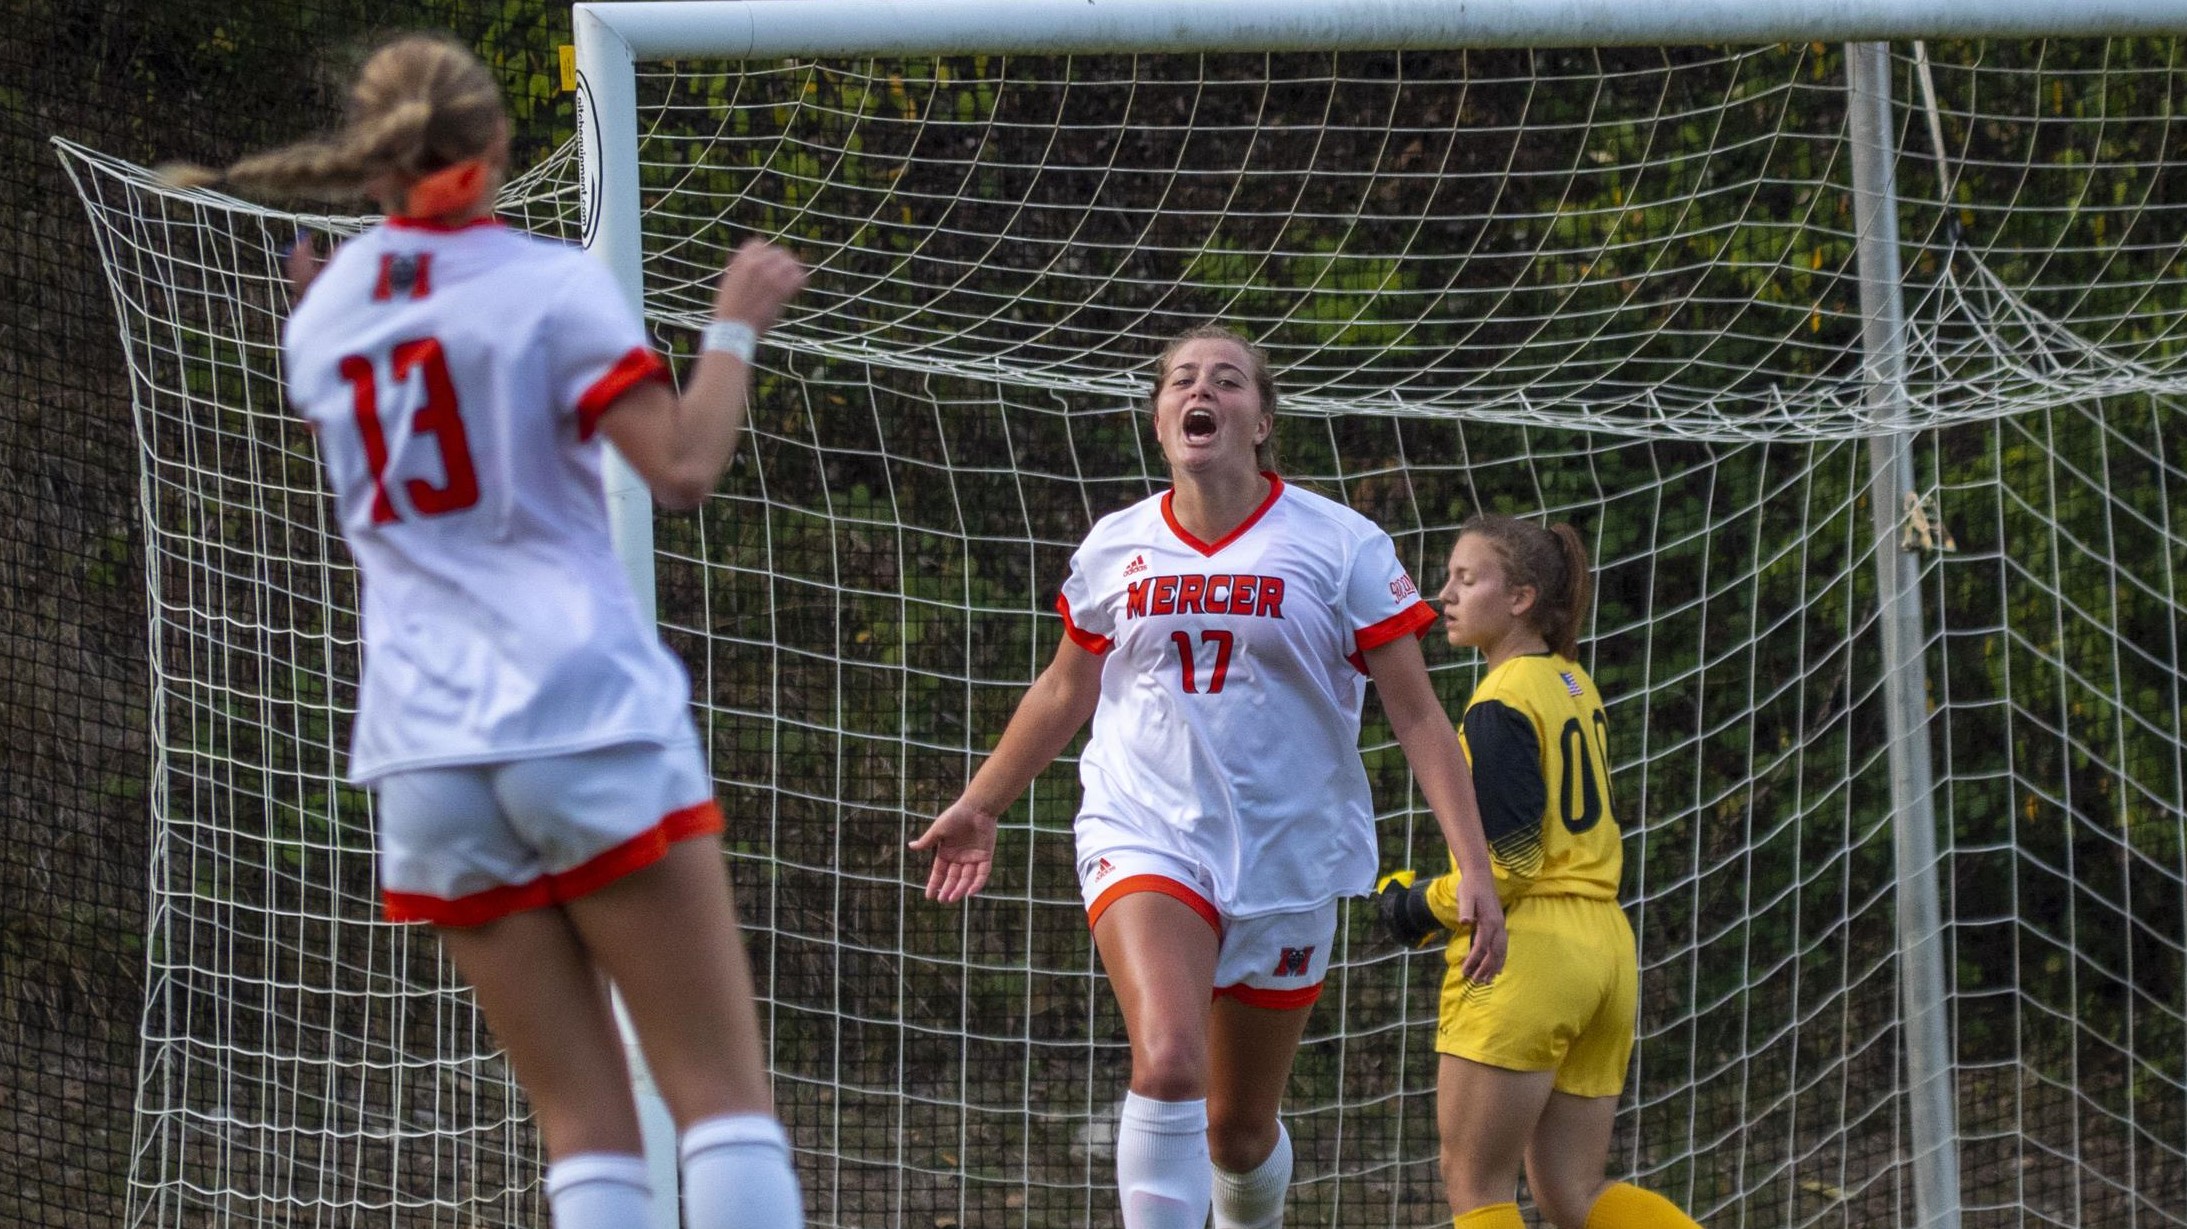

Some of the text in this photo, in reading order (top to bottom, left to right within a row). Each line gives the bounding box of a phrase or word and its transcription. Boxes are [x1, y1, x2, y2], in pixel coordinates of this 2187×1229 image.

[338, 336, 479, 524] 13
[1123, 564, 1148, 577] adidas
[1126, 574, 1285, 620] MERCER
[1171, 629, 1233, 694] 17
